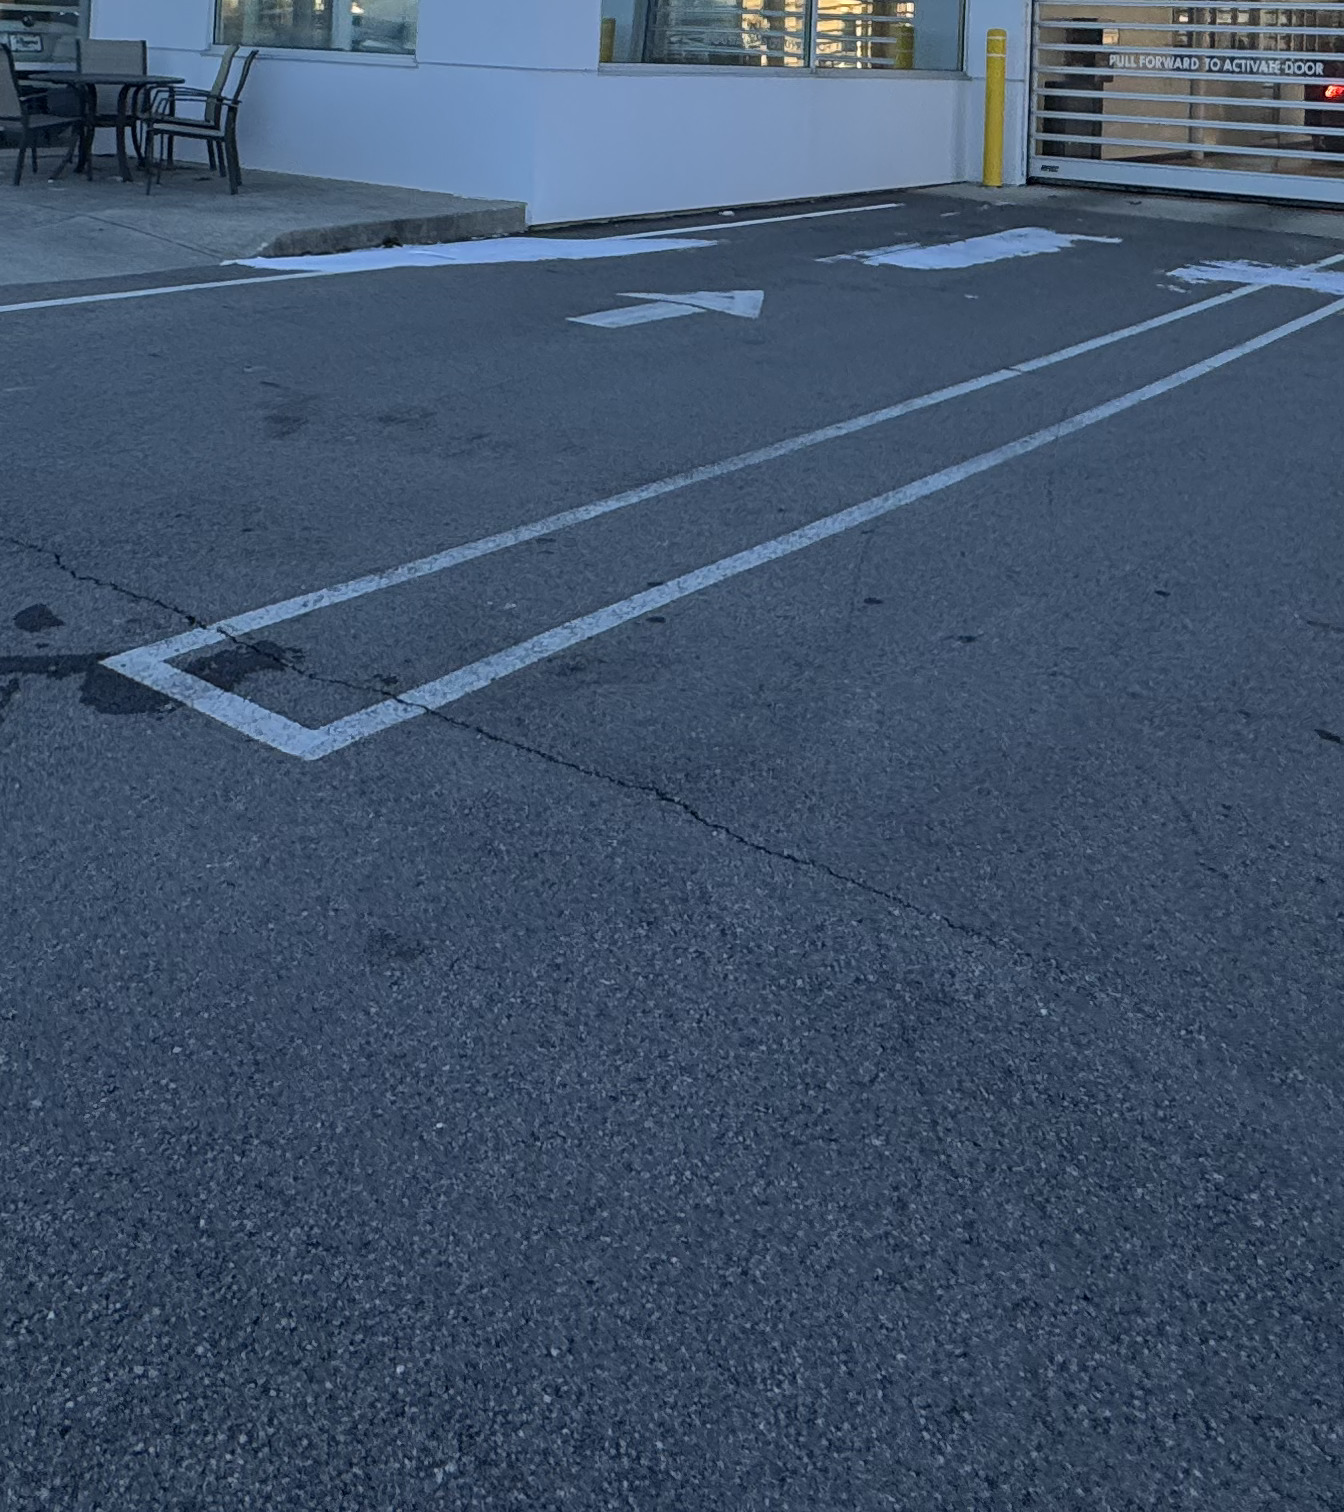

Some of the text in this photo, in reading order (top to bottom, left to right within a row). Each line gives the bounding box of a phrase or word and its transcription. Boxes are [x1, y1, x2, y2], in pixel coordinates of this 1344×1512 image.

[1109, 54, 1324, 76] PULL FORWARD TO ACTIVATE DOOR
